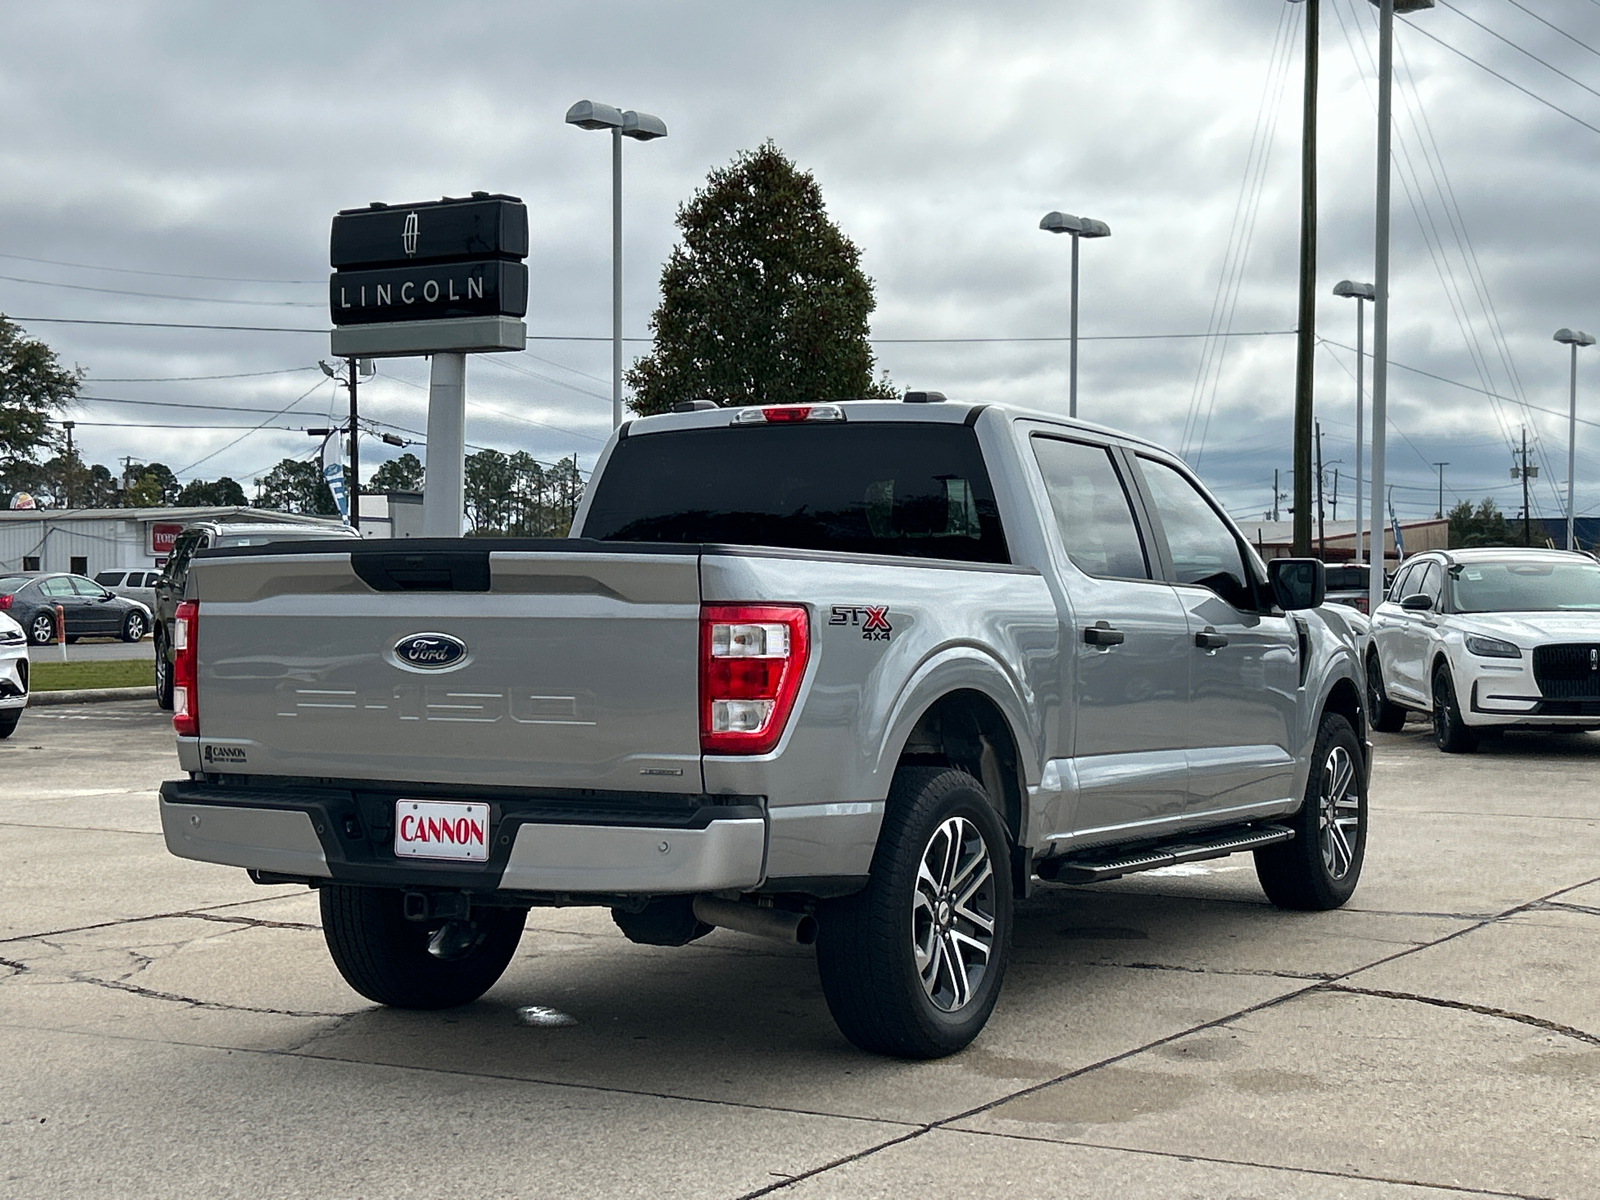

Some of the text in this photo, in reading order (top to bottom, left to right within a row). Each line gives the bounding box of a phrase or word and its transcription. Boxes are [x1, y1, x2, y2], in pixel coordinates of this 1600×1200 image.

[341, 276, 483, 308] LINCOLN
[155, 533, 176, 544] TOR
[828, 605, 893, 632] STX
[408, 639, 450, 661] Ford
[212, 746, 247, 757] CANNON
[400, 815, 484, 846] CANNON
